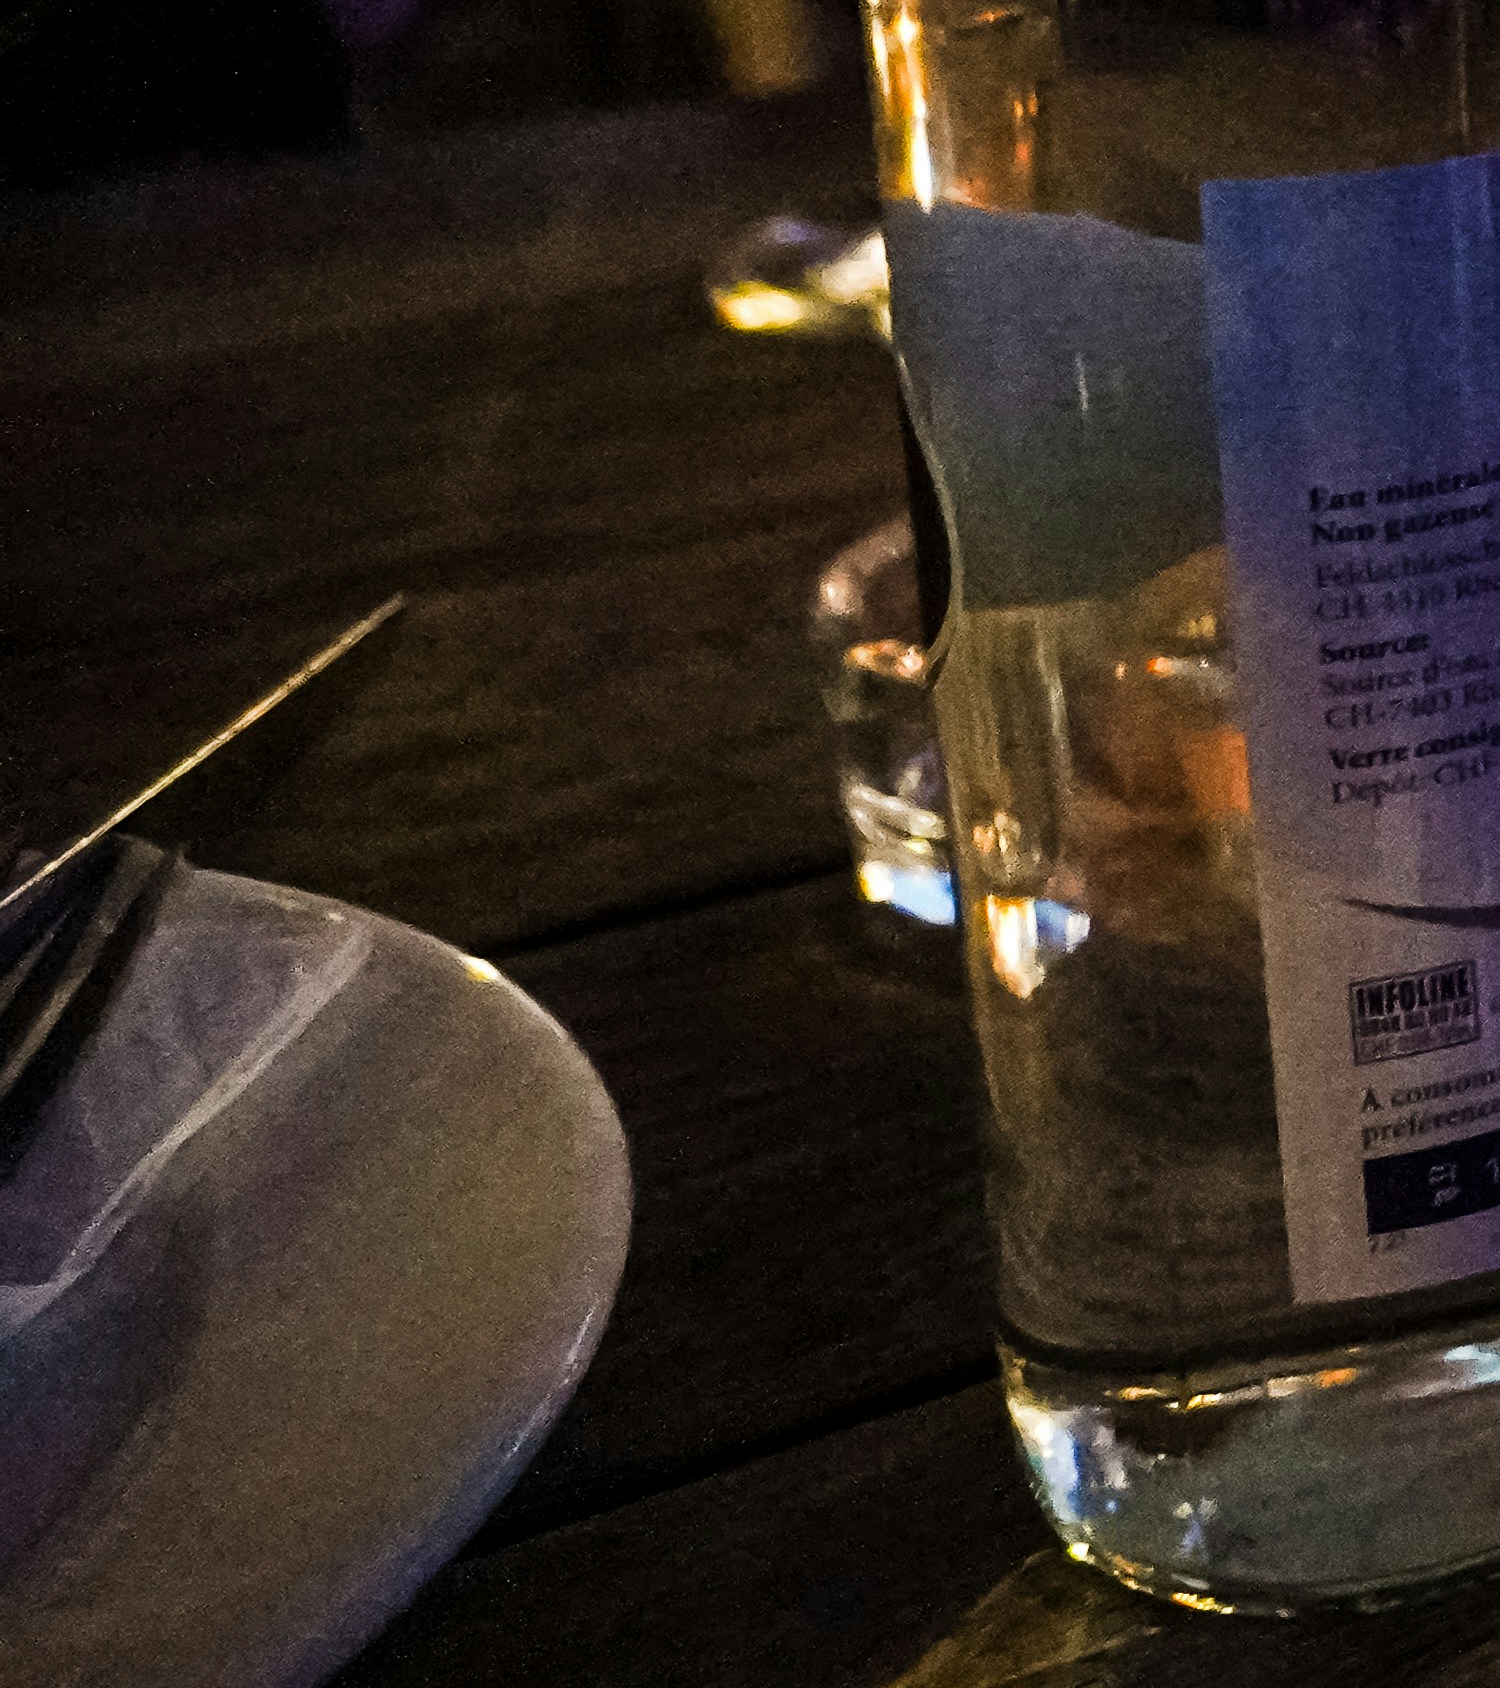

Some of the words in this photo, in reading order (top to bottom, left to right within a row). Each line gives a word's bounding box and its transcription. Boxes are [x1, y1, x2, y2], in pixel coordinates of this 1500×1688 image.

[1311, 520, 1377, 547] Non
[1328, 745, 1411, 771] Verre
[1355, 966, 1471, 1017] INFOLINE
